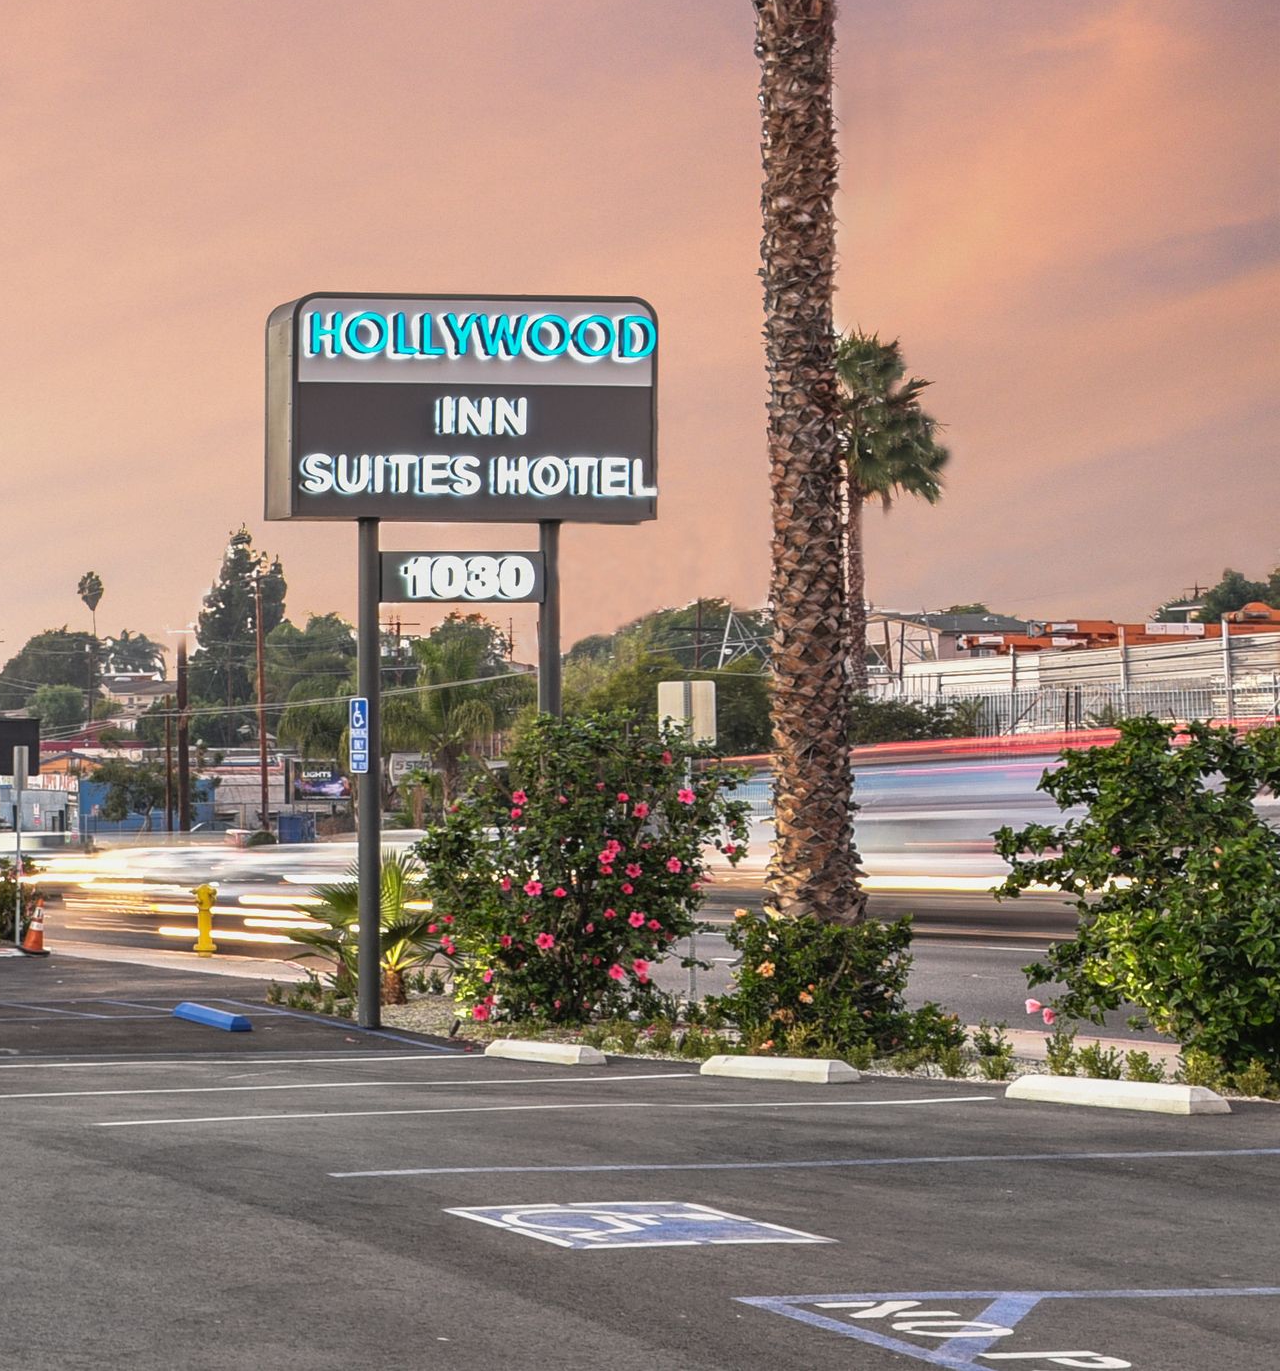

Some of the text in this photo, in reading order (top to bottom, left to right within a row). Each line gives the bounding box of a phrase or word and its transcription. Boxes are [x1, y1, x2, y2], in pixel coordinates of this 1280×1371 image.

[304, 312, 657, 363] HOLLYWOOD
[436, 396, 528, 436] INN
[301, 454, 657, 498] SUITES HOTEL
[402, 556, 535, 599] 1030
